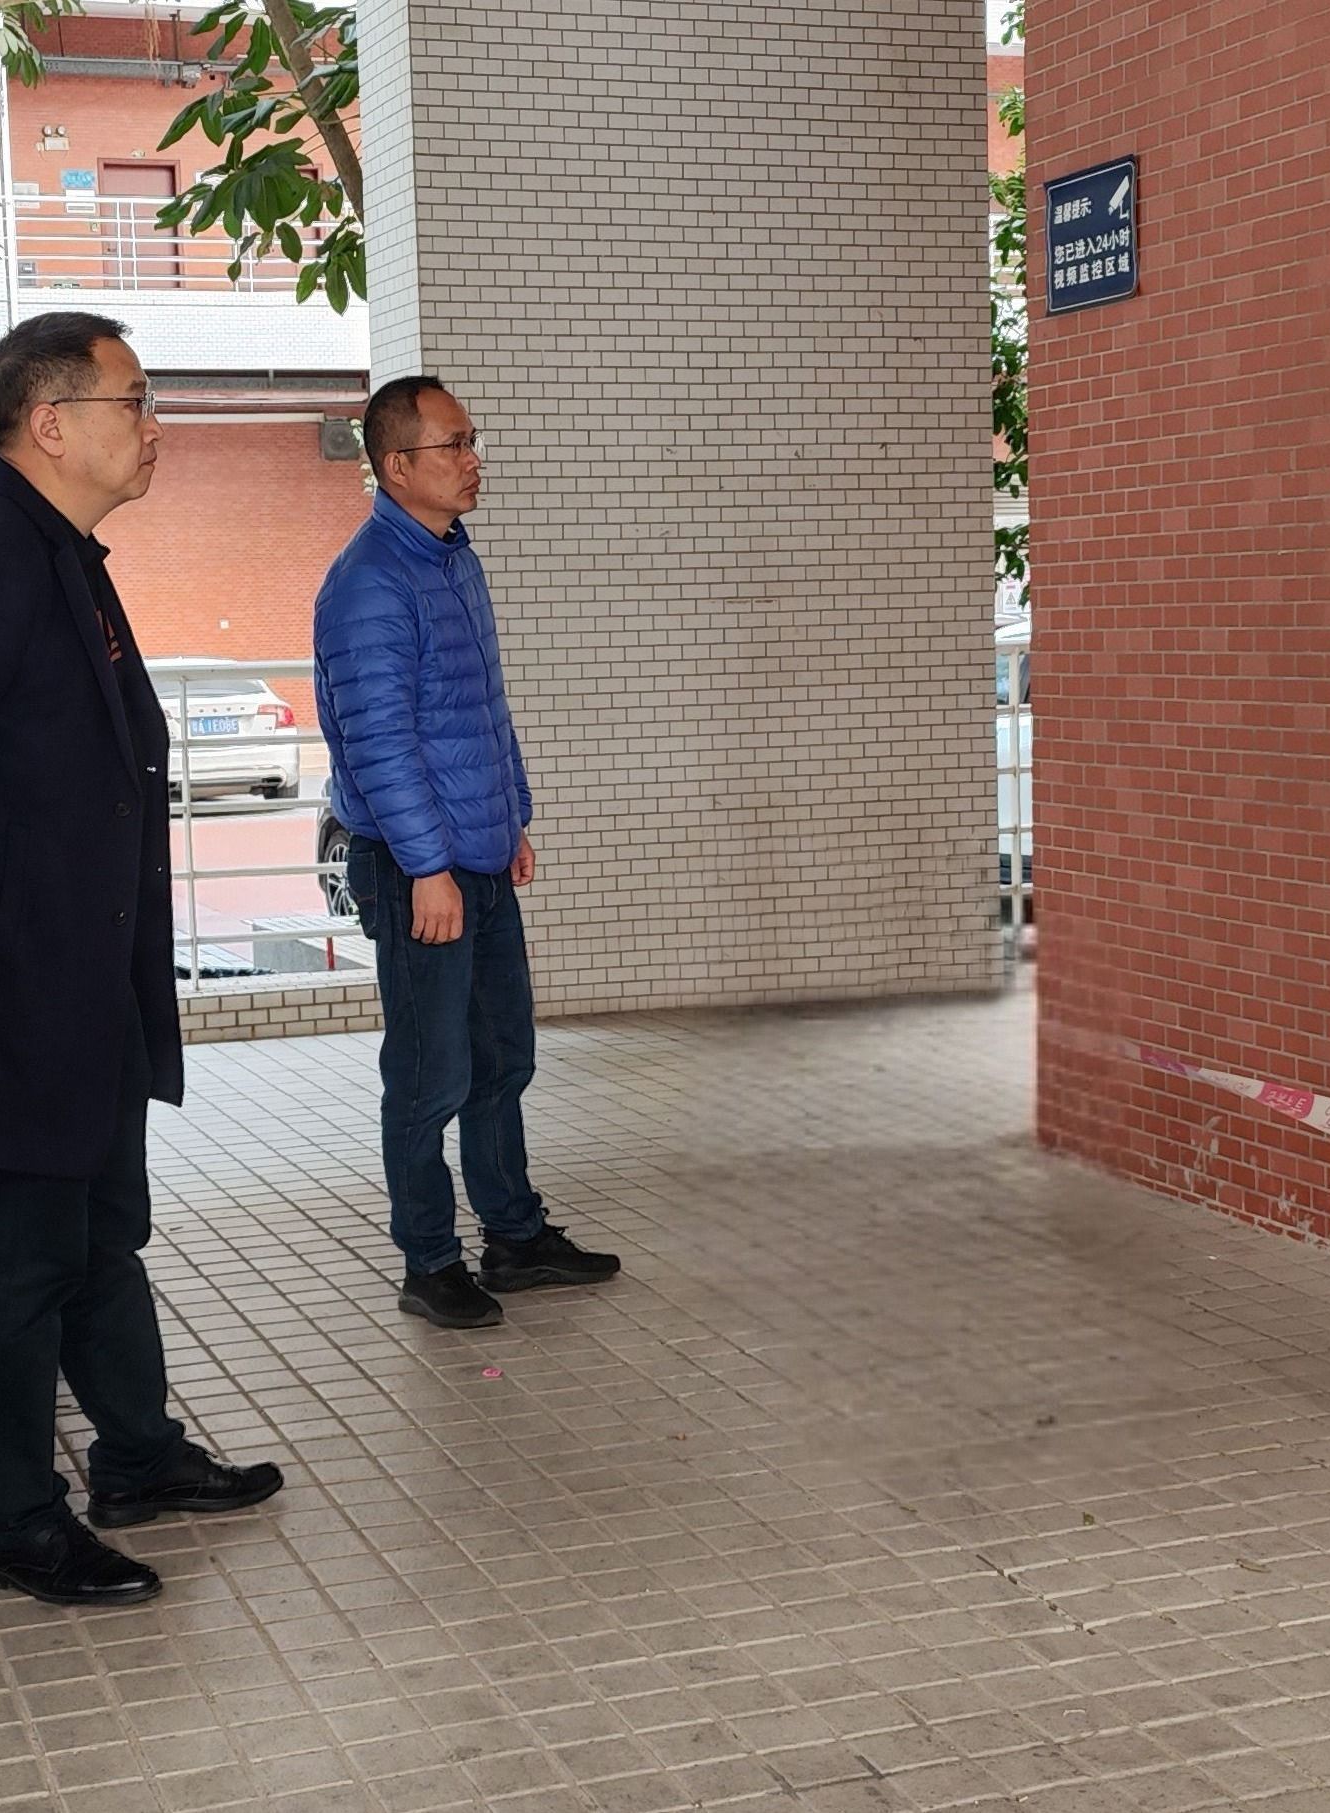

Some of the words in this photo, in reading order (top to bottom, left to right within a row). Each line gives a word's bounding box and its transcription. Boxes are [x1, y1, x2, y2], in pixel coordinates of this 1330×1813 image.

[1053, 197, 1093, 225] 温馨提示
[1053, 225, 1132, 265] 您已进入24小时
[1053, 251, 1131, 290] 视频监控区域
